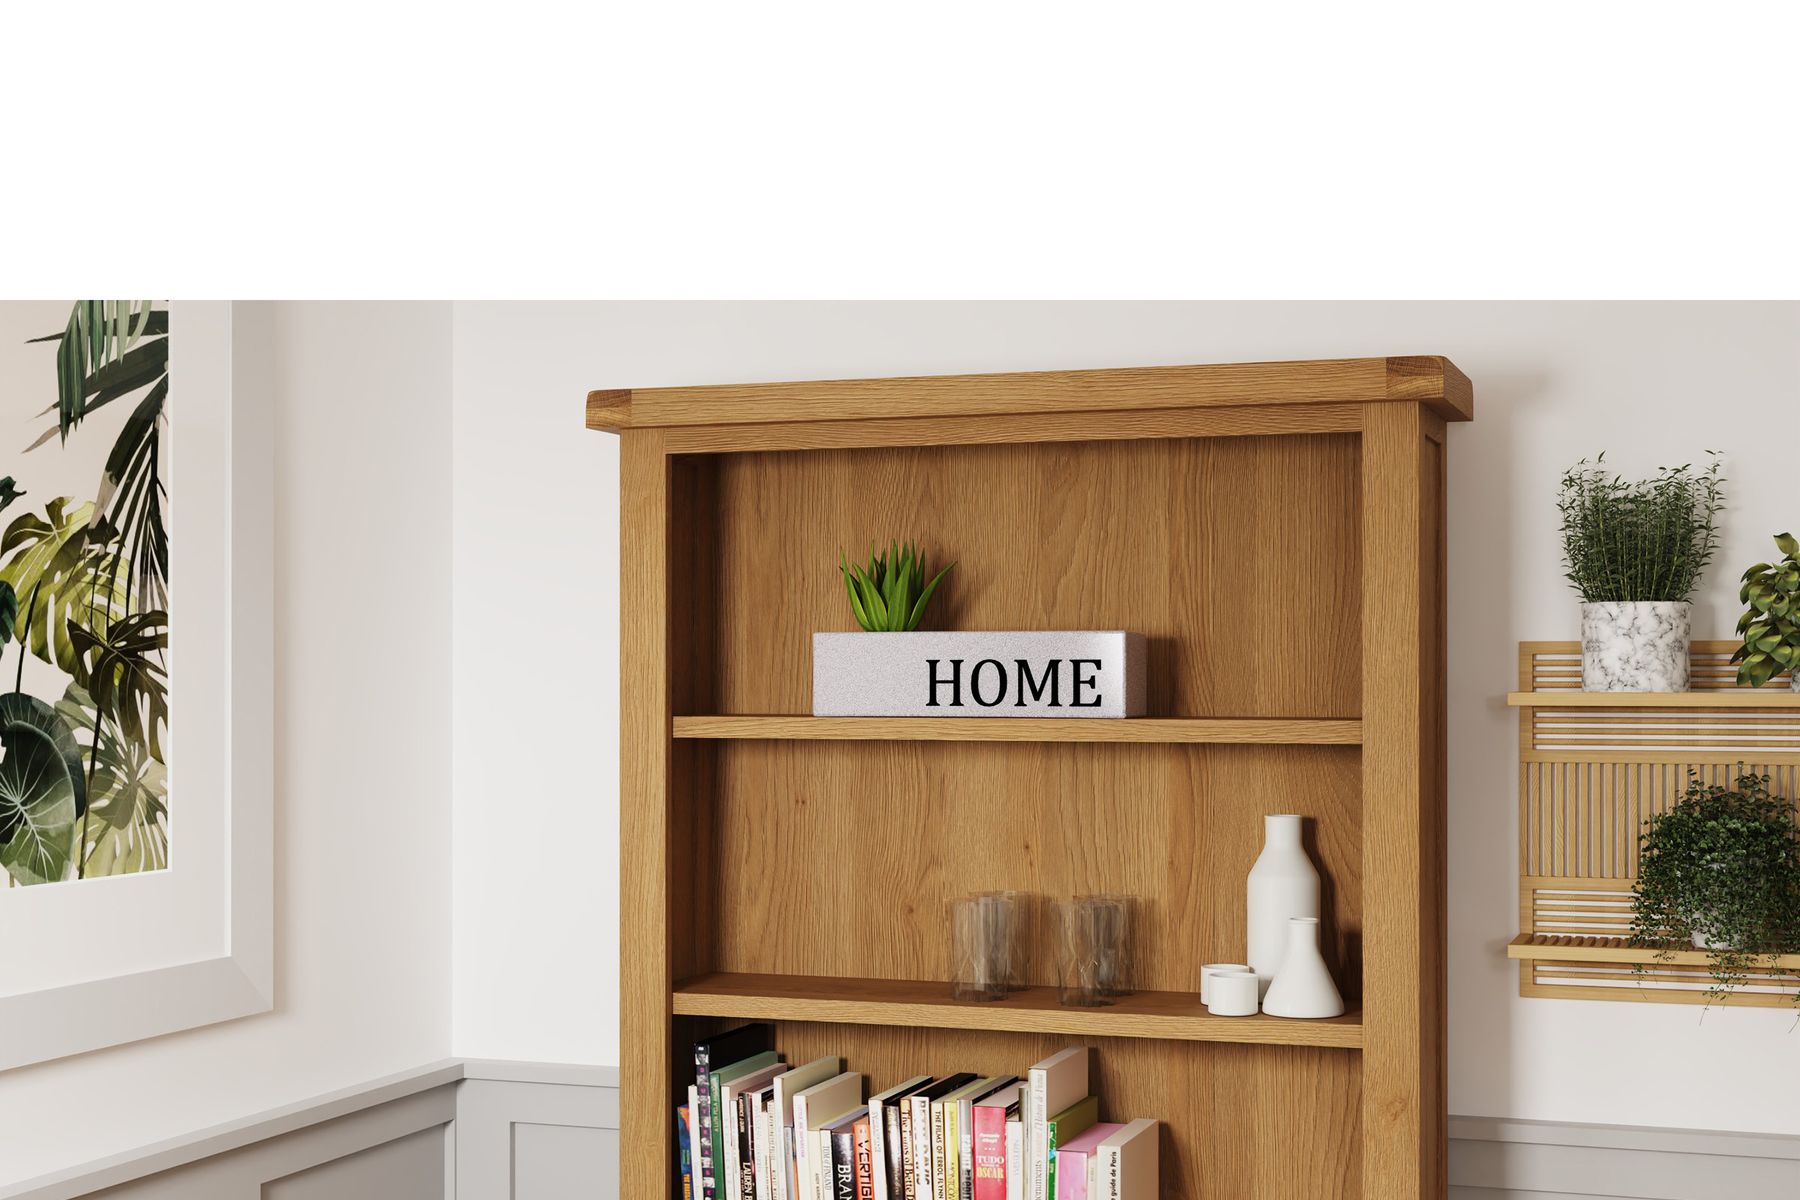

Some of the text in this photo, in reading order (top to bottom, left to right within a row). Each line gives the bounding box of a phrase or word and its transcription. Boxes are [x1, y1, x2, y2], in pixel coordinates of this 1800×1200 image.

[926, 659, 1102, 706] HOME
[936, 1146, 942, 1154] OF
[976, 1156, 1004, 1164] TUDO
[743, 1162, 753, 1193] LAUREN
[977, 1167, 1004, 1178] OSCAR
[1110, 1169, 1116, 1177] de
[905, 1169, 914, 1192] Bette
